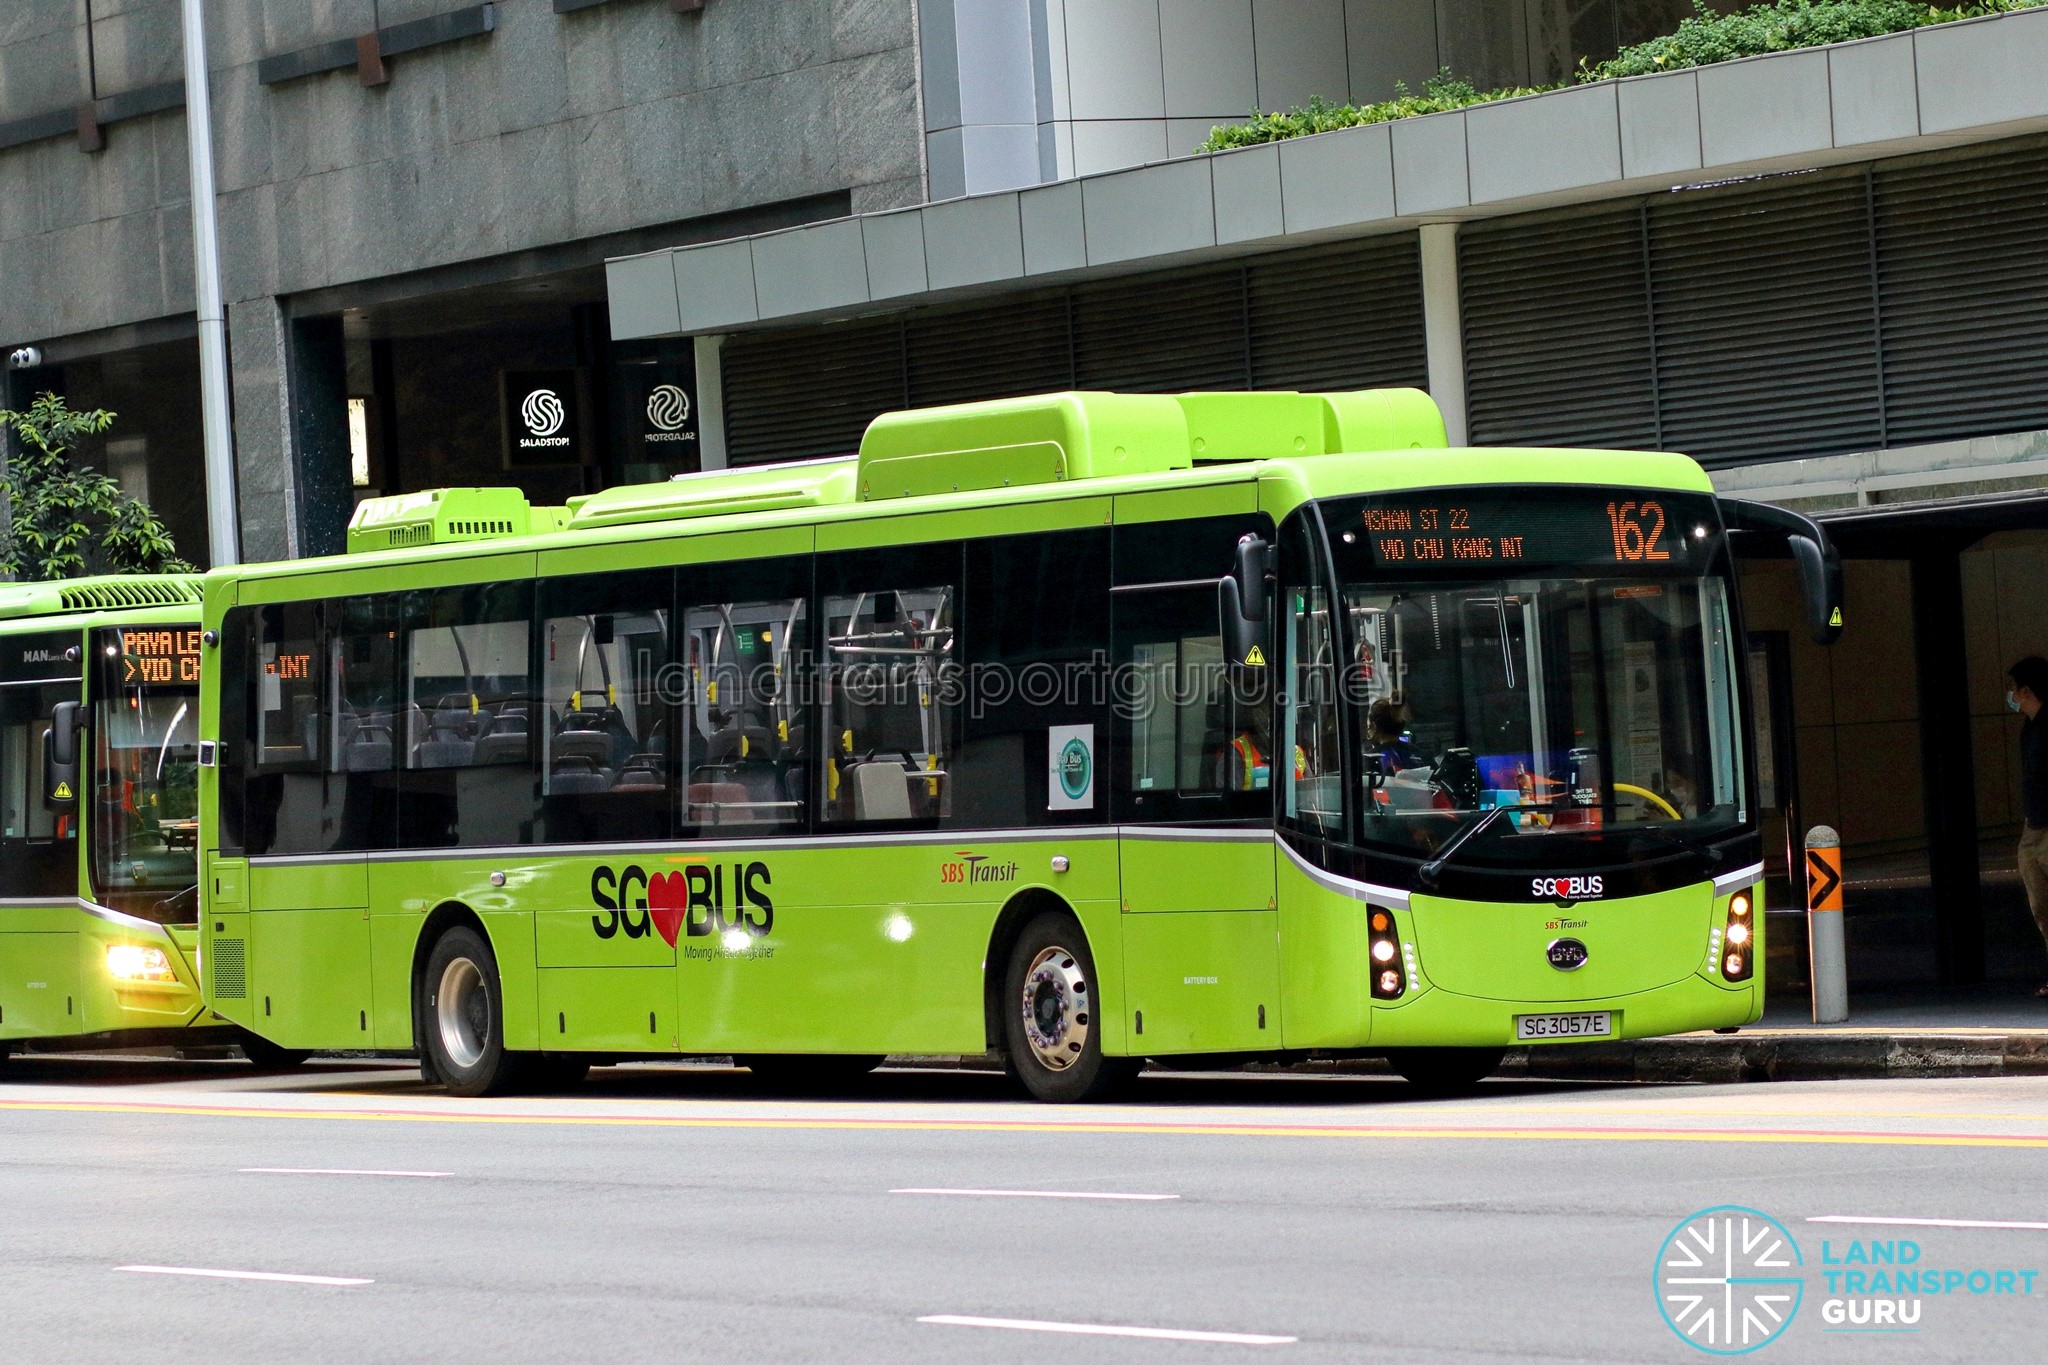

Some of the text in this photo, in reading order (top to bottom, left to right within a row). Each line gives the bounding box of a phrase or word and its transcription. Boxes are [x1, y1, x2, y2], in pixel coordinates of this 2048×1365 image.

[520, 438, 570, 447] SALADSTOP!
[1420, 509, 1439, 530] ST
[1449, 509, 1470, 529] 22
[1606, 501, 1670, 560] 162
[1380, 537, 1524, 560] YIO CHU KANG INT
[124, 631, 202, 655] PAYA LE
[24, 650, 48, 662] MAN
[140, 659, 172, 681] YIO
[279, 655, 310, 678] INT
[941, 856, 1019, 886] SBS Transit
[1545, 917, 1589, 930] SBS Transit
[684, 945, 713, 962] Moving
[1552, 947, 1585, 962] BYD
